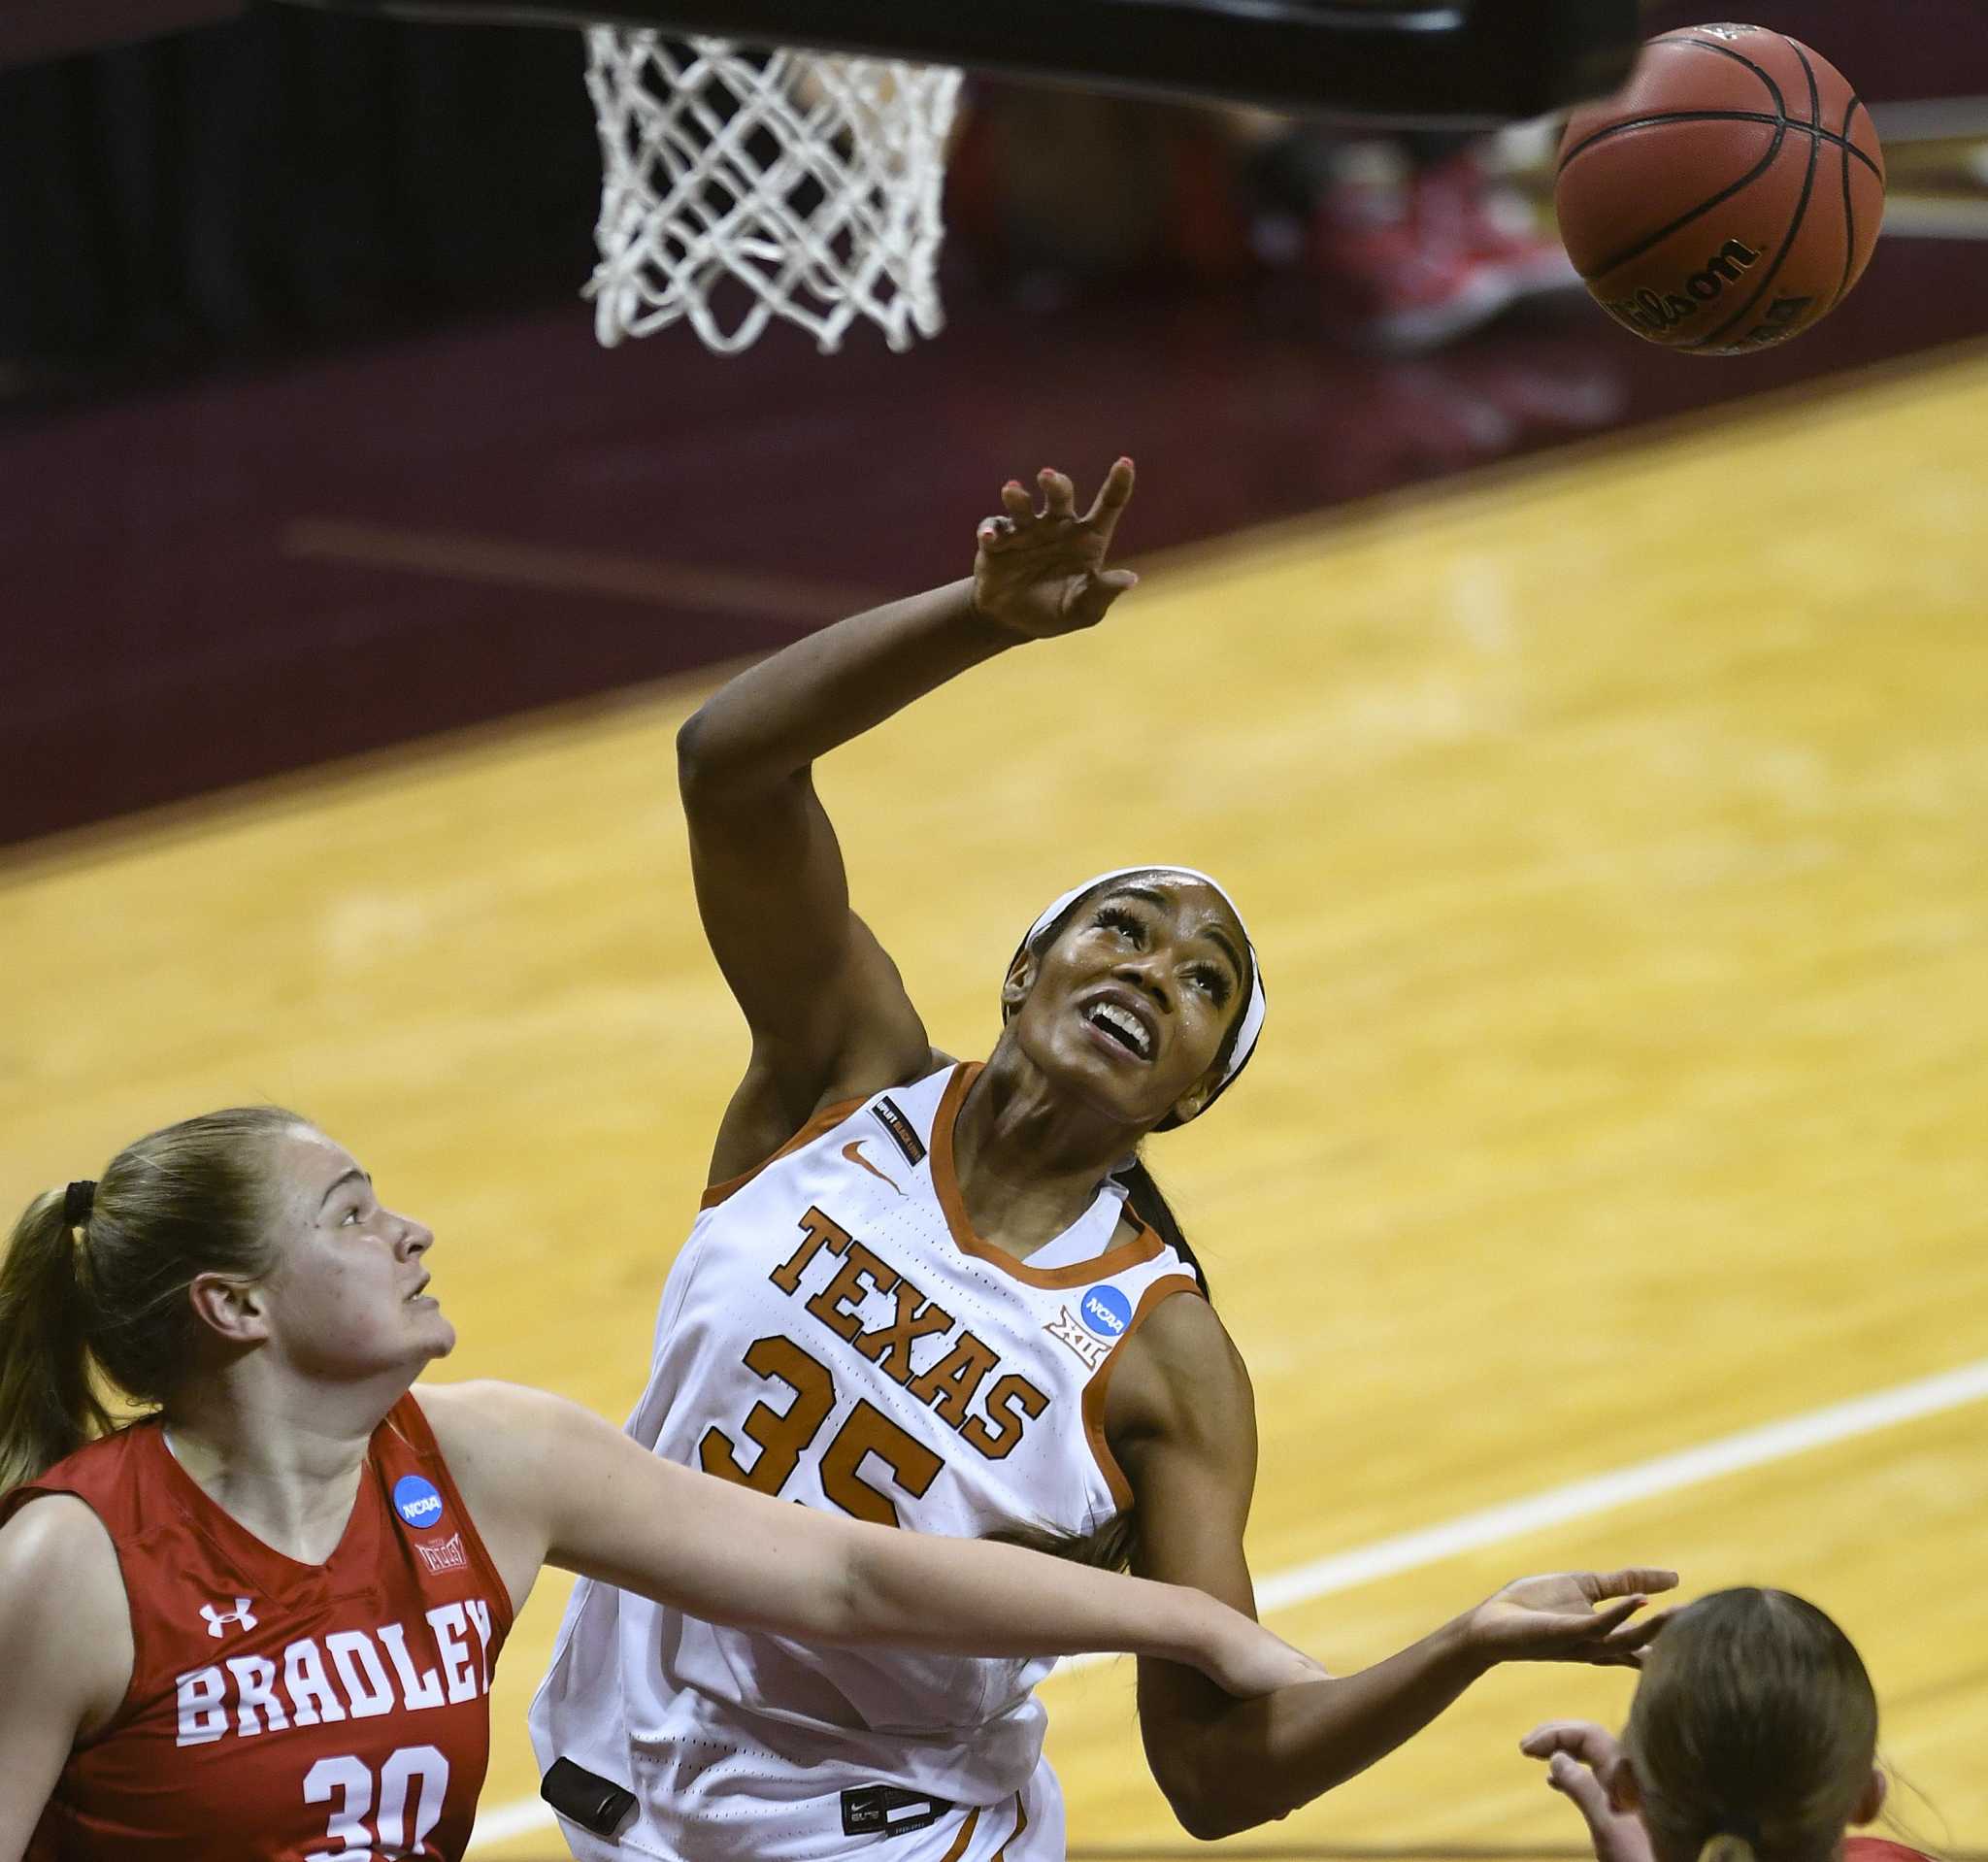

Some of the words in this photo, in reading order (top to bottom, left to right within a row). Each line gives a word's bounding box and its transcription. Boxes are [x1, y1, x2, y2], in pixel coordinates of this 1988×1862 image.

[769, 1205, 1050, 1460] TEXAS
[1086, 1297, 1124, 1334] NCAA
[699, 1335, 945, 1530] 35
[402, 1495, 441, 1519] NCAA
[176, 1599, 492, 1747] BRADLEY
[303, 1745, 449, 1862] 30
